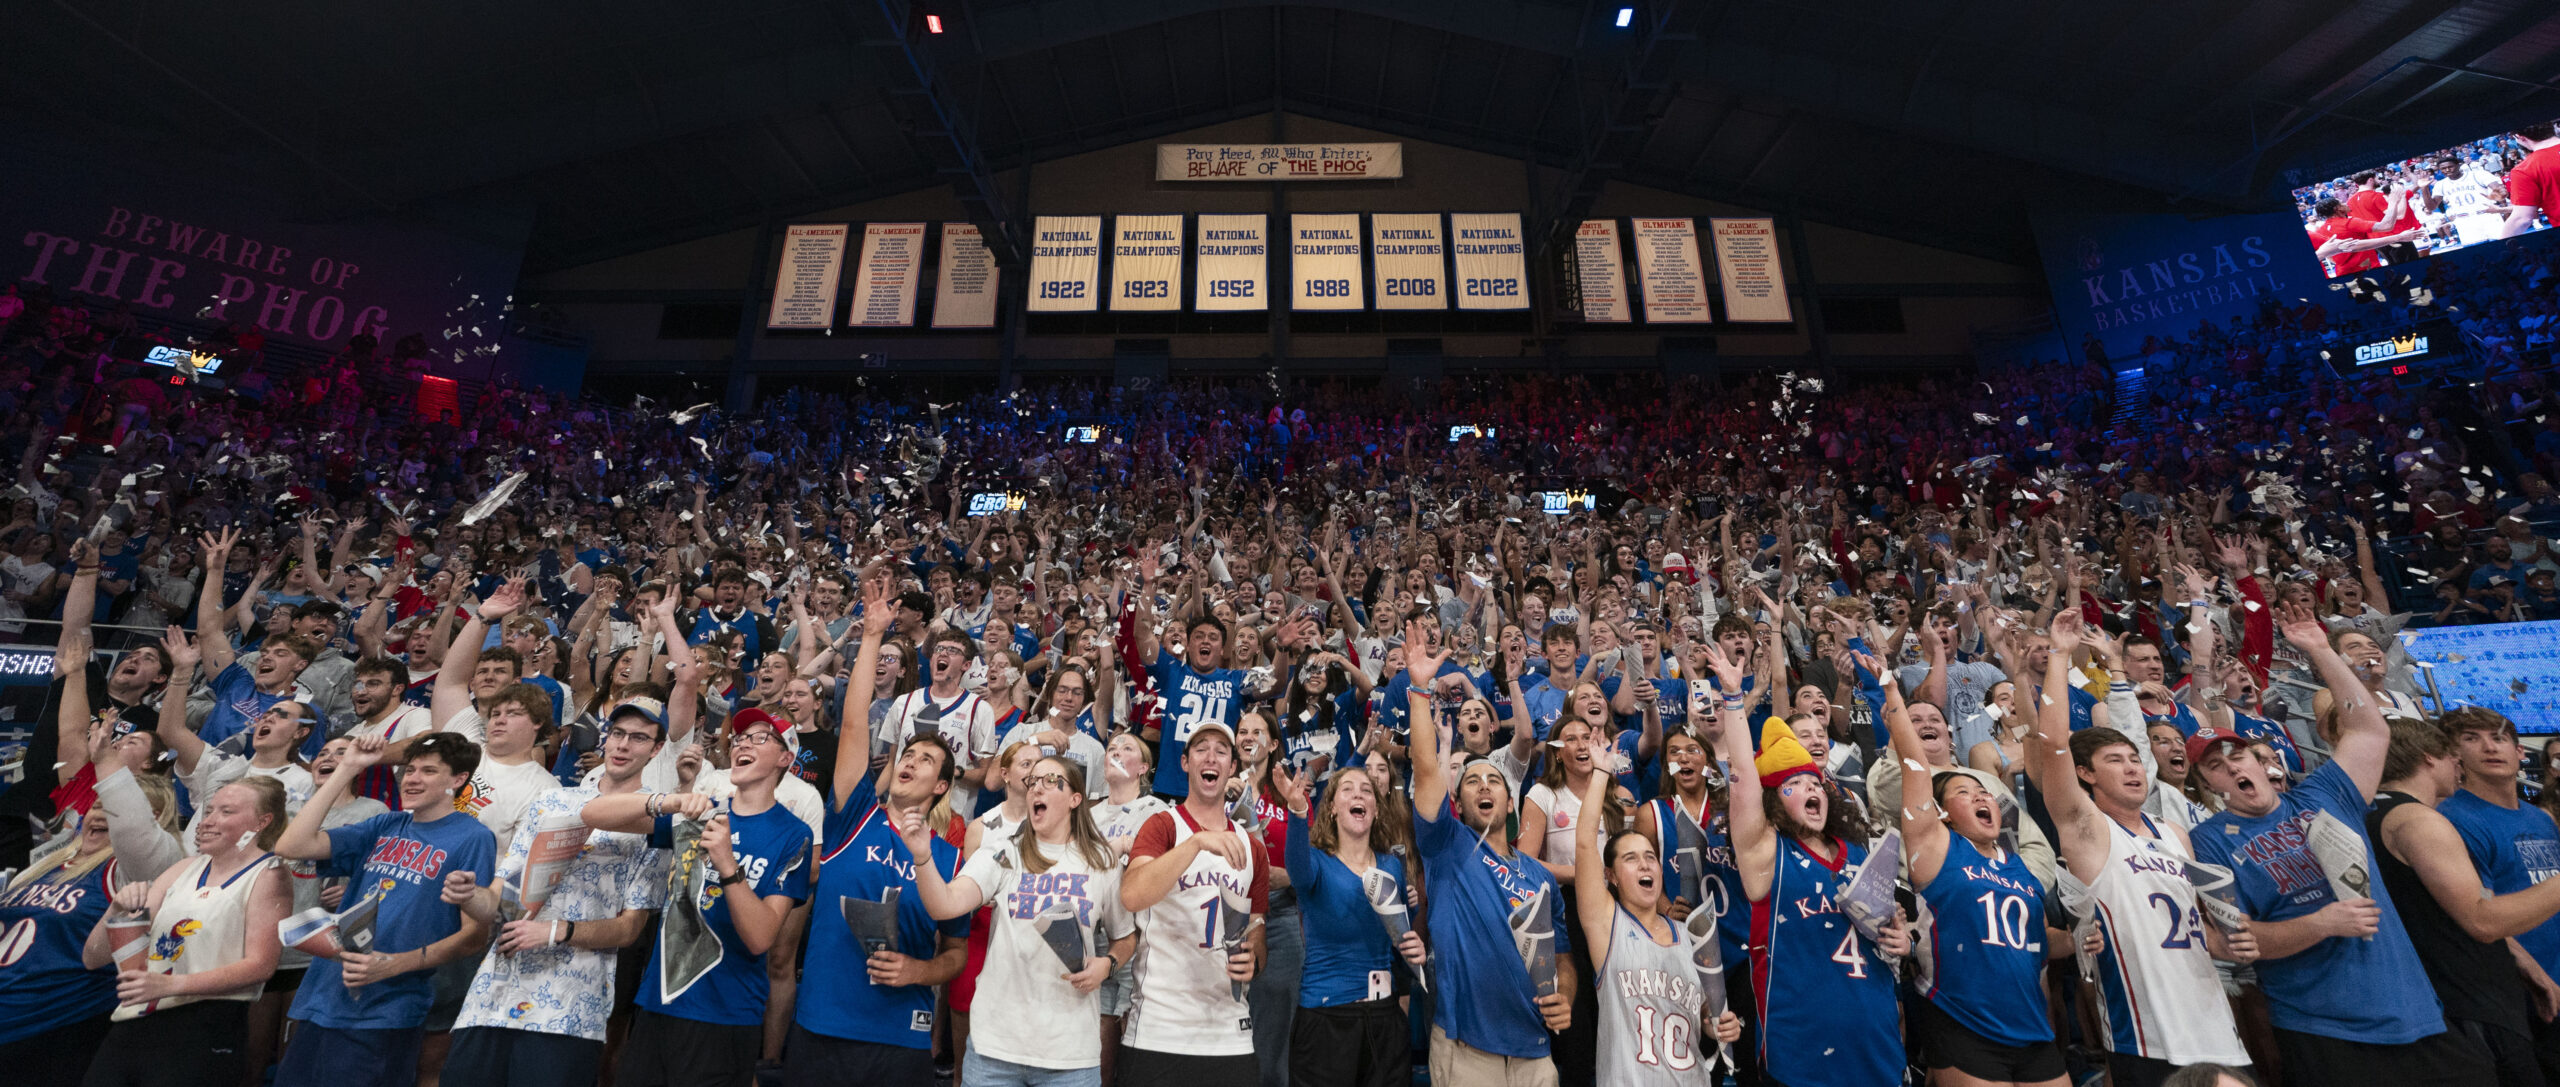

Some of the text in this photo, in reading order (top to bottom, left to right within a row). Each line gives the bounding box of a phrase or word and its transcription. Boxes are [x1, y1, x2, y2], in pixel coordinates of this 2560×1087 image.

[1187, 148, 1213, 162] Pay
[1220, 147, 1255, 161] Heed,
[1284, 147, 1314, 160] Who
[1320, 147, 1370, 160] Enter:
[1187, 161, 1248, 177] BEWARE
[1258, 161, 1280, 176] OF
[1041, 231, 1093, 242] NATIONAL
[1123, 230, 1175, 241] NATIONAL
[1206, 230, 1259, 240] NATIONAL
[1300, 229, 1353, 240] NATIONAL
[1381, 229, 1435, 240] NATIONAL
[1461, 229, 1515, 239] NATIONAL
[100, 206, 360, 290] BEWARE OF
[1033, 246, 1097, 257] CHAMPIONS
[1116, 245, 1181, 256] CHAMPIONS
[1199, 245, 1264, 255] CHAMPIONS
[1294, 244, 1359, 255] CHAMPIONS
[1376, 244, 1441, 255] CHAMPIONS
[1456, 244, 1521, 254] CHAMPIONS
[2082, 236, 2271, 308] KANSAS
[21, 230, 391, 345] THE PHOG
[1040, 281, 1085, 298] 1922
[1123, 280, 1168, 298] 1923
[1209, 280, 1254, 297] 1952
[1305, 279, 1350, 297] 1988
[1386, 278, 1435, 296] 2008
[1466, 278, 1518, 296] 2022
[2094, 272, 2286, 332] BASKETBALL
[2392, 365, 2408, 376] EXIT
[1180, 675, 1233, 699] KANSAS
[1173, 693, 1228, 742] 24
[1017, 872, 1090, 897] ROCK
[1962, 865, 2034, 898] KANSAS
[2207, 902, 2226, 917] DAILY
[1198, 895, 1220, 949] 1
[1976, 890, 2029, 950] 10
[1831, 923, 1869, 979] 4
[1617, 968, 1702, 1016] KANSAS
[1635, 1004, 1697, 1071] 10
